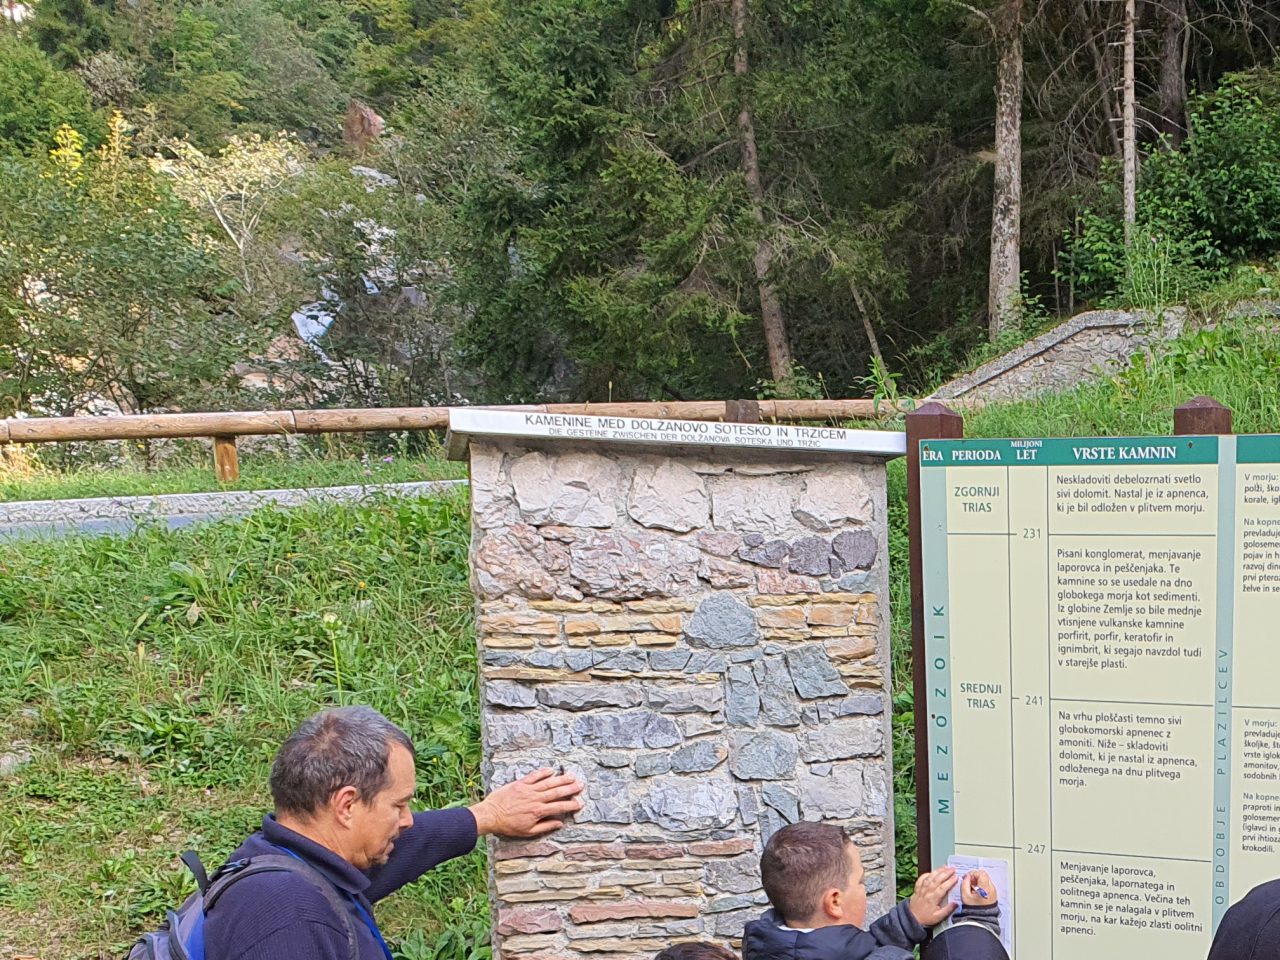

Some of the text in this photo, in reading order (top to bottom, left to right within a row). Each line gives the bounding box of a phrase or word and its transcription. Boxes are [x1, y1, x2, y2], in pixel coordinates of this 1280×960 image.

[525, 415, 592, 428] KAMENINE
[598, 418, 625, 429] MED
[714, 424, 771, 436] SOTESKO
[777, 428, 788, 437] IN
[612, 431, 657, 439] ZWISCHEN
[735, 437, 772, 445] SOTESKA
[1010, 440, 1043, 449] MILIJONI
[923, 450, 944, 461] ERA
[952, 450, 1002, 461] PERIODA
[1016, 449, 1038, 460] LET
[1072, 446, 1177, 460] VRSTE KAMNIN
[1056, 474, 1202, 485] Neskladoviti debelozrnati svetlo
[1244, 473, 1251, 481] V
[1252, 473, 1279, 484] morju:
[954, 486, 1000, 497] ZGORNJI
[1056, 488, 1209, 501] sivi dolomit. Nastal je iz apnenca,
[1244, 484, 1265, 494] polži,
[1244, 495, 1269, 504] korale,
[962, 502, 992, 513] TRIAS
[1057, 502, 1065, 512] ki
[1066, 502, 1075, 515] je
[1077, 502, 1089, 513] bil
[1090, 502, 1128, 513] odložen
[1138, 502, 1172, 514] plitvem
[1174, 503, 1206, 515] morju.
[1244, 518, 1255, 526] Na
[1023, 528, 1041, 539] 231
[1057, 548, 1202, 562] Pisani konglomerat, menjavanje
[1057, 562, 1181, 575] laporovca in peščenjaka. Te
[1057, 576, 1193, 588] kamnine so se usedale na dno
[1057, 590, 1201, 603] globokega morja kot sedimenti.
[1057, 603, 1202, 618] Iz globine Zemlje so bile mednje
[1057, 617, 1185, 629] vtisnjene vulkanske kamnine
[1058, 631, 1174, 643] porfirit, porfir, keratofir in
[1058, 644, 1202, 658] ignimbrit, ki segajo navzdol tudi
[1066, 658, 1099, 670] starejše
[1101, 658, 1128, 670] plasti.
[960, 683, 1002, 694] SREDNJI
[966, 698, 996, 709] TRIAS
[1025, 695, 1043, 706] 241
[933, 606, 950, 814] MEZOZOIK
[1058, 711, 1182, 725] Na vrhu ploščasti temno sivi
[1058, 725, 1172, 739] globokomorski apnenec z
[1058, 738, 1169, 752] amoniti. Niže skladoviti
[1059, 750, 1198, 767] dolomit, ki je nastal iz apnenca,
[1059, 764, 1110, 777] odloženega
[1125, 767, 1143, 777] dnu
[1145, 768, 1181, 781] plitvega
[1215, 650, 1228, 905] OBDOBJE PLAZILCEV
[1059, 778, 1087, 788] morja.
[1028, 843, 1046, 855] 247
